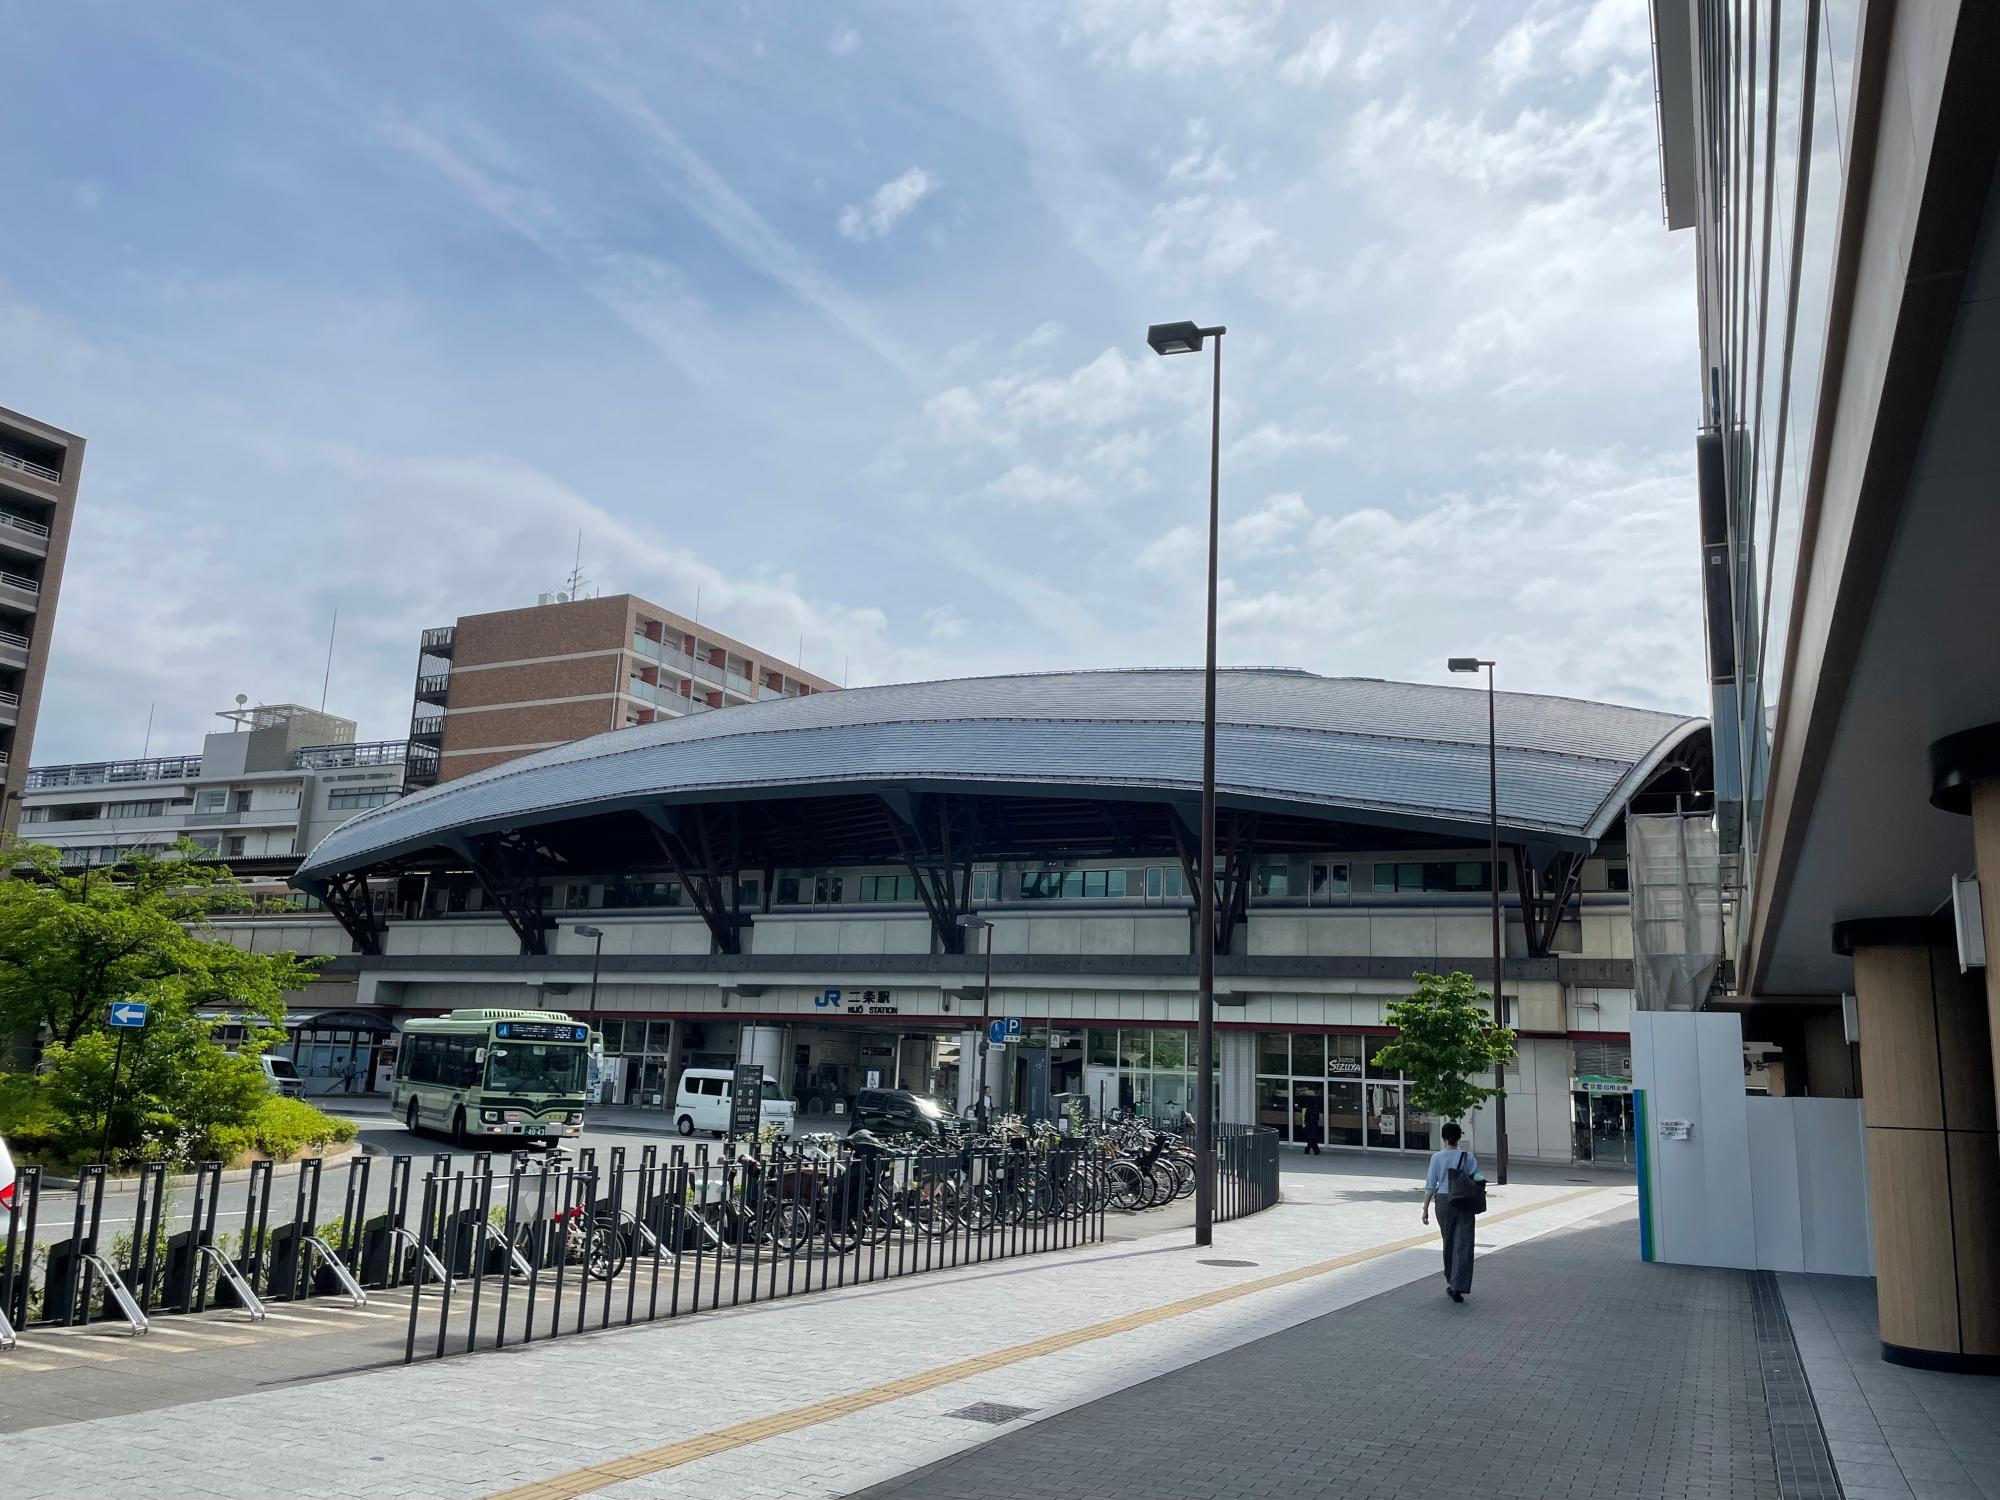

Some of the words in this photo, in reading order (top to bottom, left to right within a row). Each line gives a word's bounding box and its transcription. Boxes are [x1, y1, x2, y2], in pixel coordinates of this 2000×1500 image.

[815, 990, 841, 1007] JR
[848, 990, 890, 1004] 二条駅
[869, 1006, 898, 1014] STATION
[1009, 1020, 1018, 1032] P
